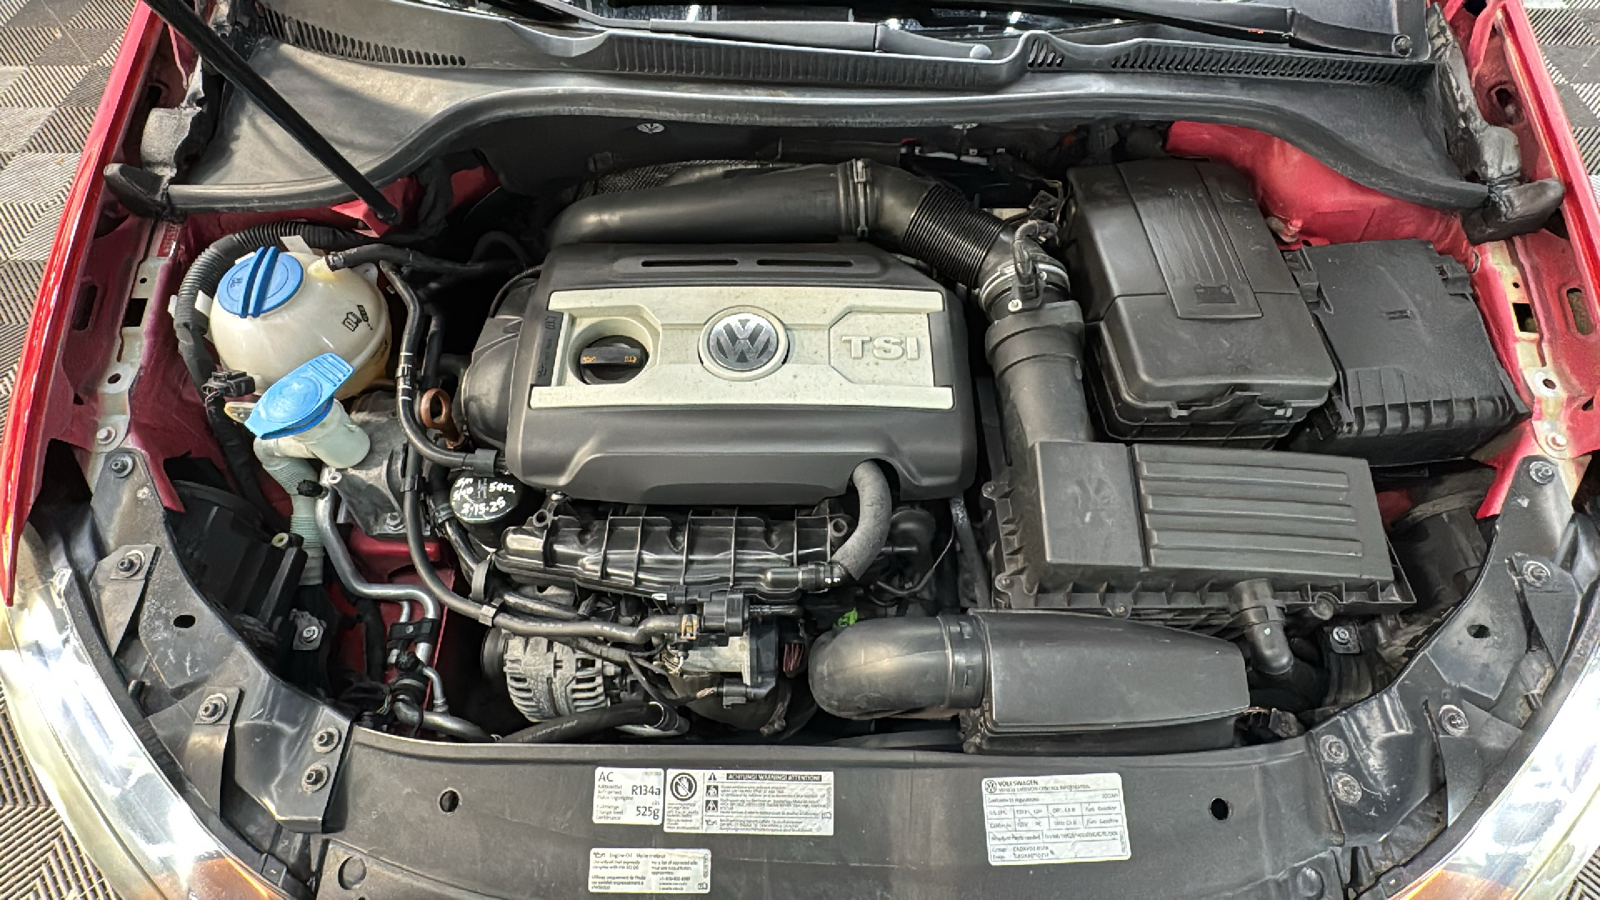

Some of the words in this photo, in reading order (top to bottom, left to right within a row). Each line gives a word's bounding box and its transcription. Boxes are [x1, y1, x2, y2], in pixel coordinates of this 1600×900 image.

[841, 336, 920, 361] TSI
[598, 771, 614, 782] AC
[631, 784, 661, 796] R134a
[636, 806, 660, 820] 525g
